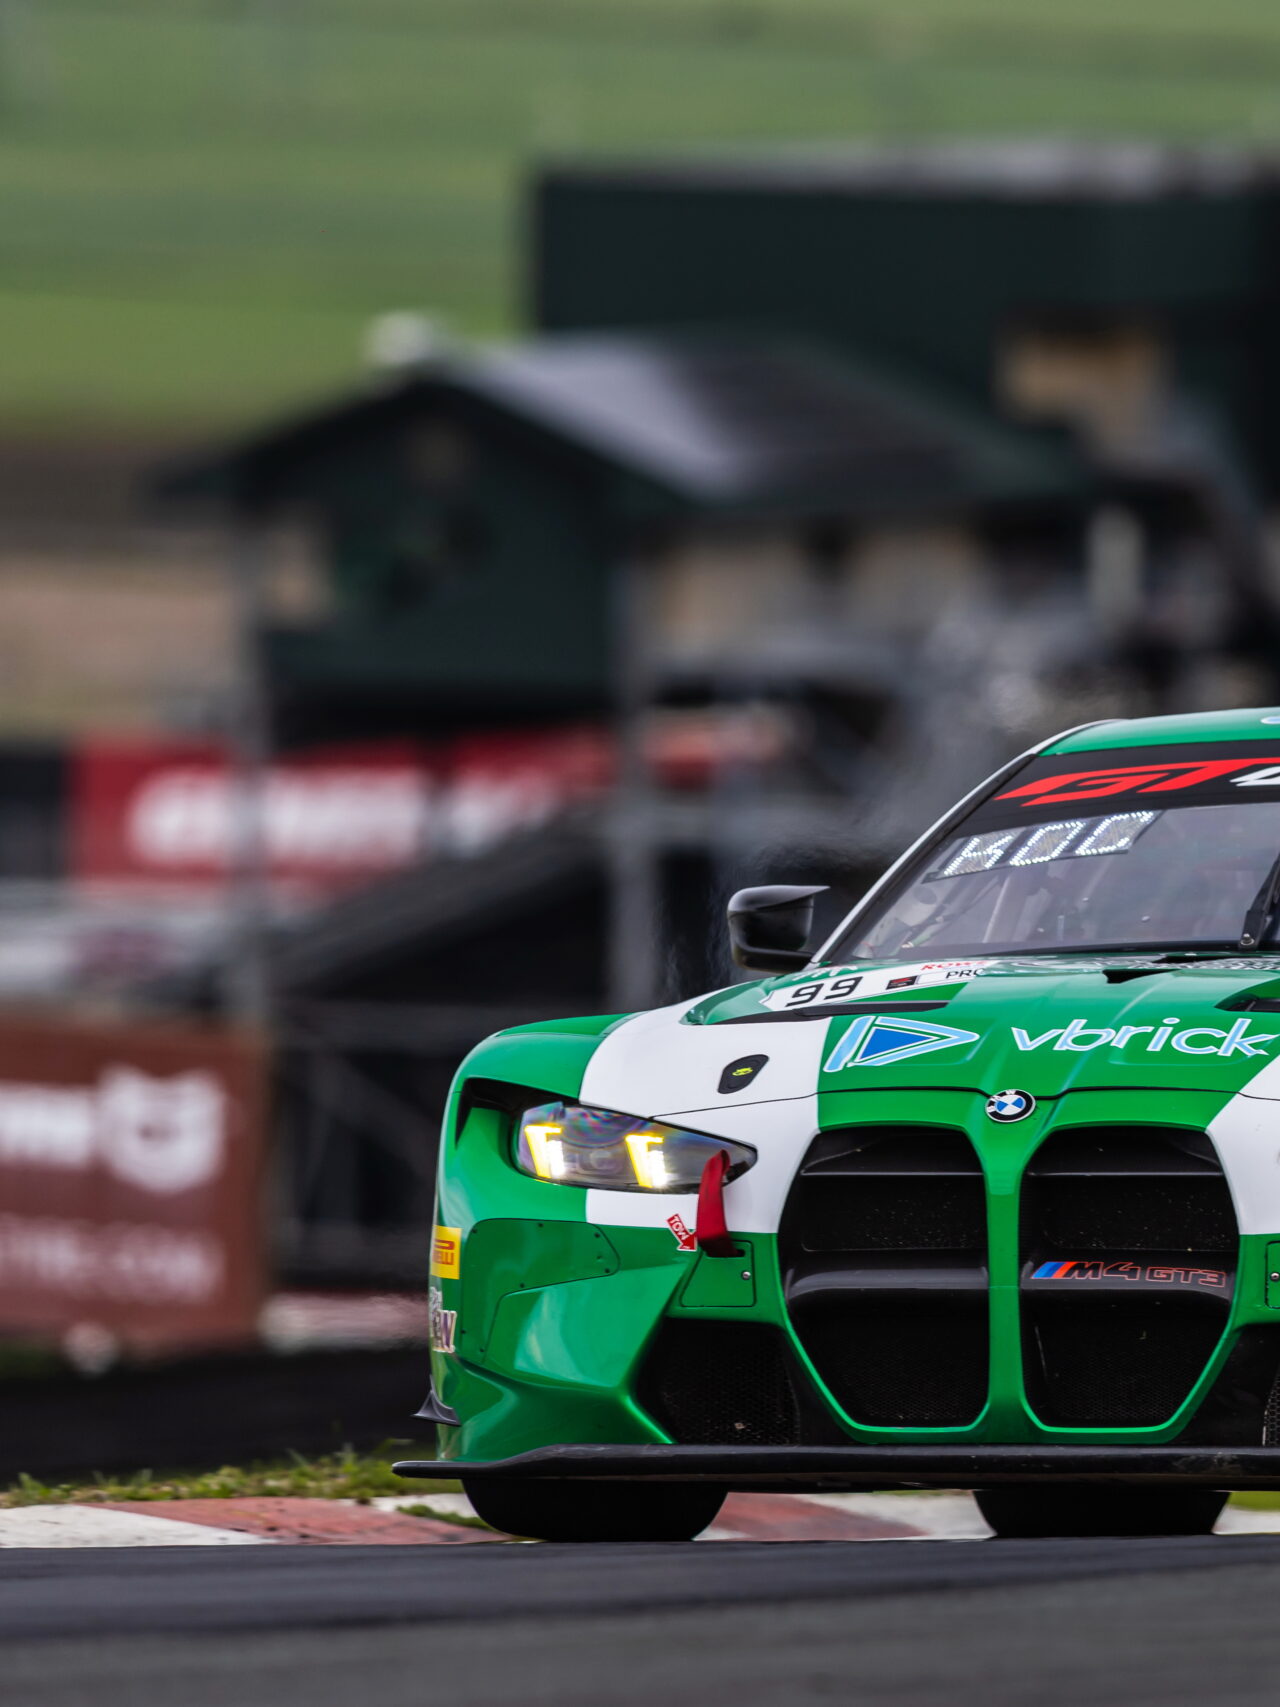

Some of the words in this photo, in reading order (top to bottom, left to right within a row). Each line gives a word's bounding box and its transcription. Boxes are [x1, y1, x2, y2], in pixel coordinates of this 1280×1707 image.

[785, 976, 863, 1008] 99
[1011, 1017, 1280, 1057] vbrick
[1060, 1261, 1141, 1281] M4
[1145, 1266, 1227, 1288] GT3
